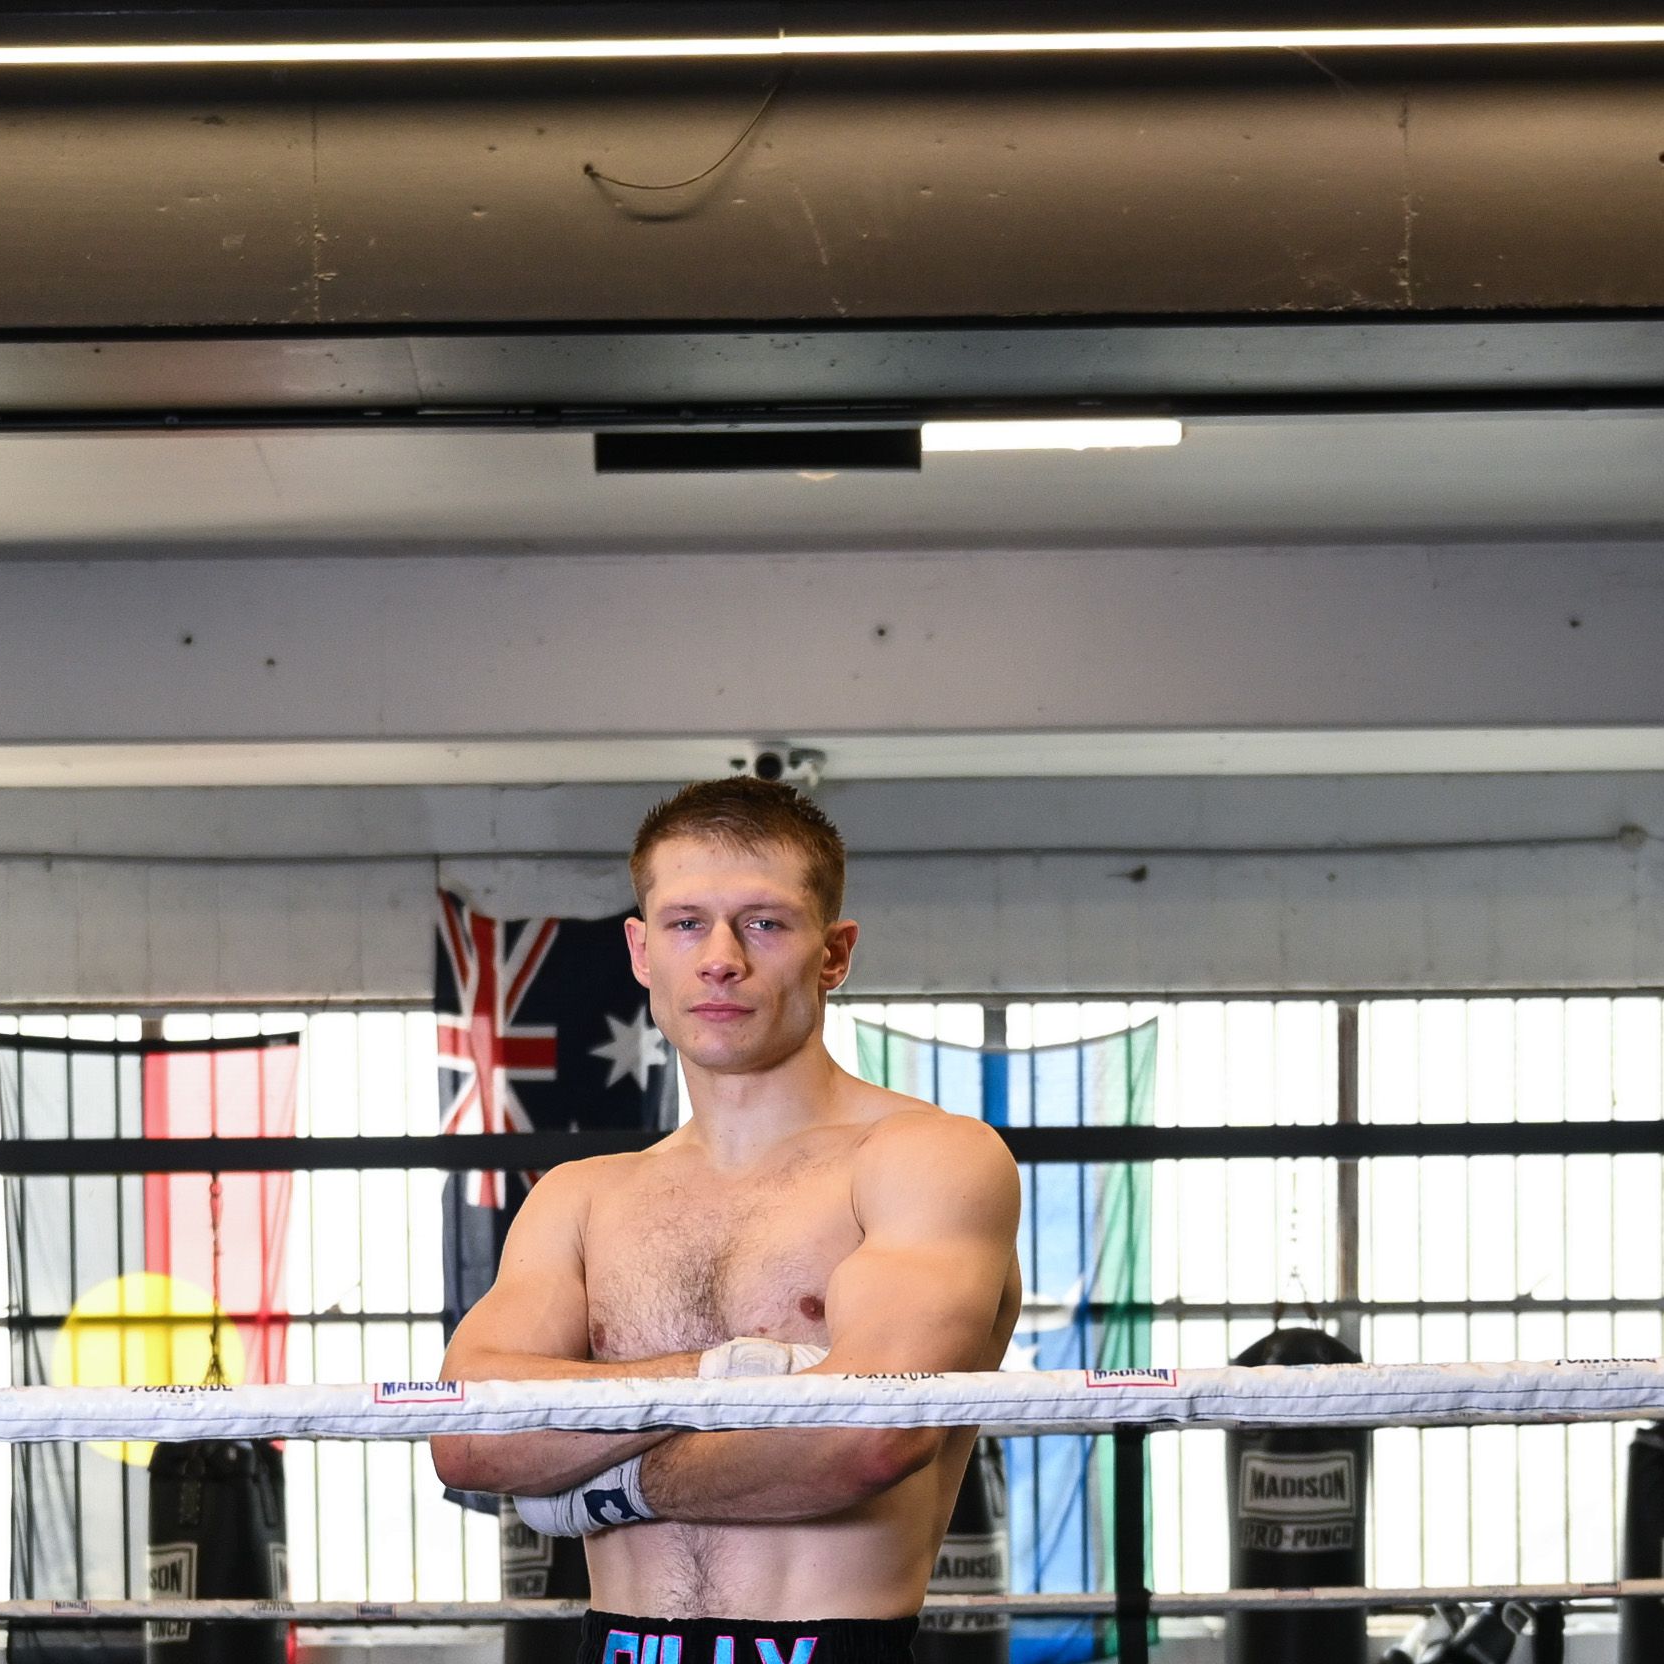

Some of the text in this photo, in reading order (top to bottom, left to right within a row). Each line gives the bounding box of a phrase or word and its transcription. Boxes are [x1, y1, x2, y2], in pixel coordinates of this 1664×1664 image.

[382, 1381, 457, 1396] MADISON
[1250, 1461, 1346, 1502] MADISON
[1244, 1521, 1353, 1549] PRO-PUNCH
